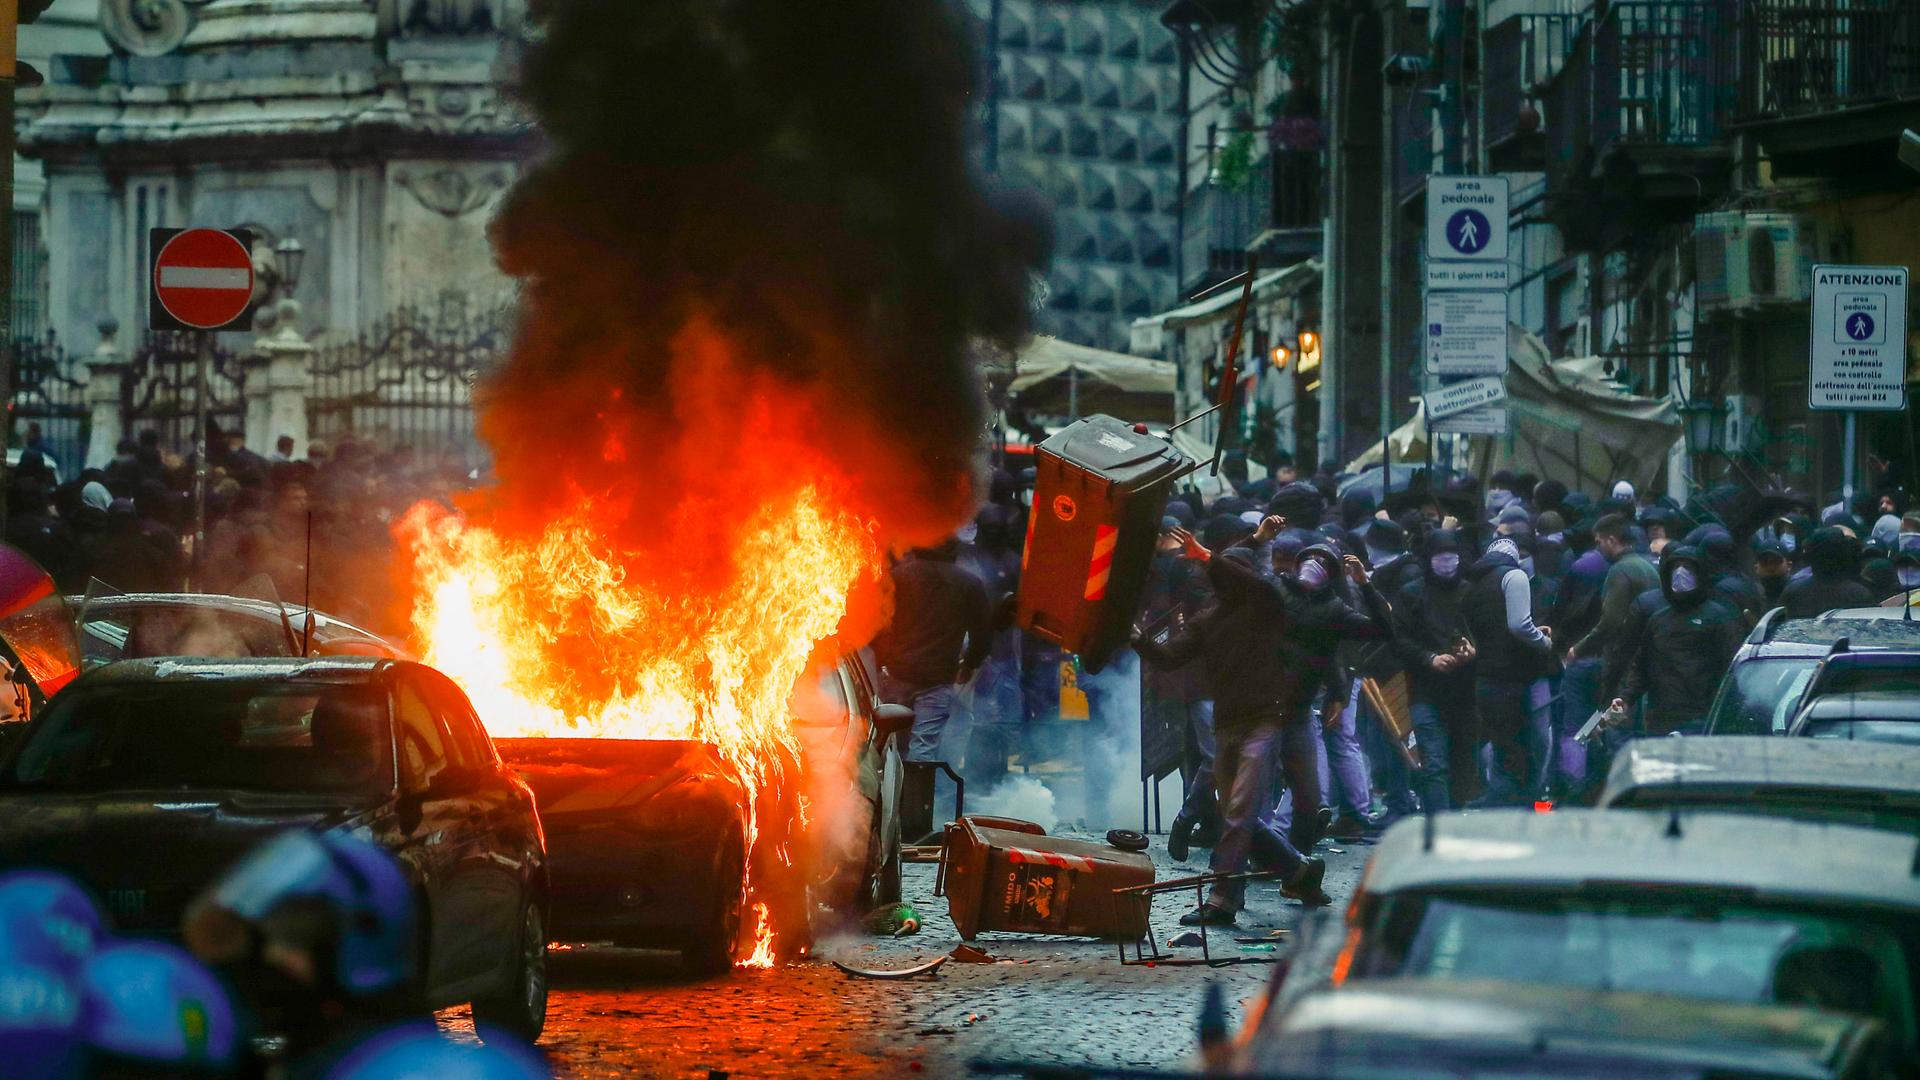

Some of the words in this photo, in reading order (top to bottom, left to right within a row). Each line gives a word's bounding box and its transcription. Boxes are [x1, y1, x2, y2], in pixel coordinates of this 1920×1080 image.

[1456, 182, 1481, 190] area
[1441, 194, 1495, 204] pedonale
[1430, 271, 1450, 279] tutti
[1457, 271, 1483, 281] giorni
[1486, 271, 1506, 279] H24
[1820, 274, 1903, 286] ATTENZIONE
[1843, 304, 1877, 312] pedonale
[1848, 348, 1856, 356] 10
[1858, 348, 1878, 356] metri
[1851, 360, 1883, 368] pedonale
[1443, 382, 1485, 399] controllo
[1815, 382, 1855, 390] elettronico
[1857, 382, 1900, 391] dell'accesso
[1434, 394, 1484, 413] elettronico
[1486, 388, 1499, 398] AP
[1850, 394, 1870, 402] giorni
[1003, 872, 1016, 912] UMIDO
